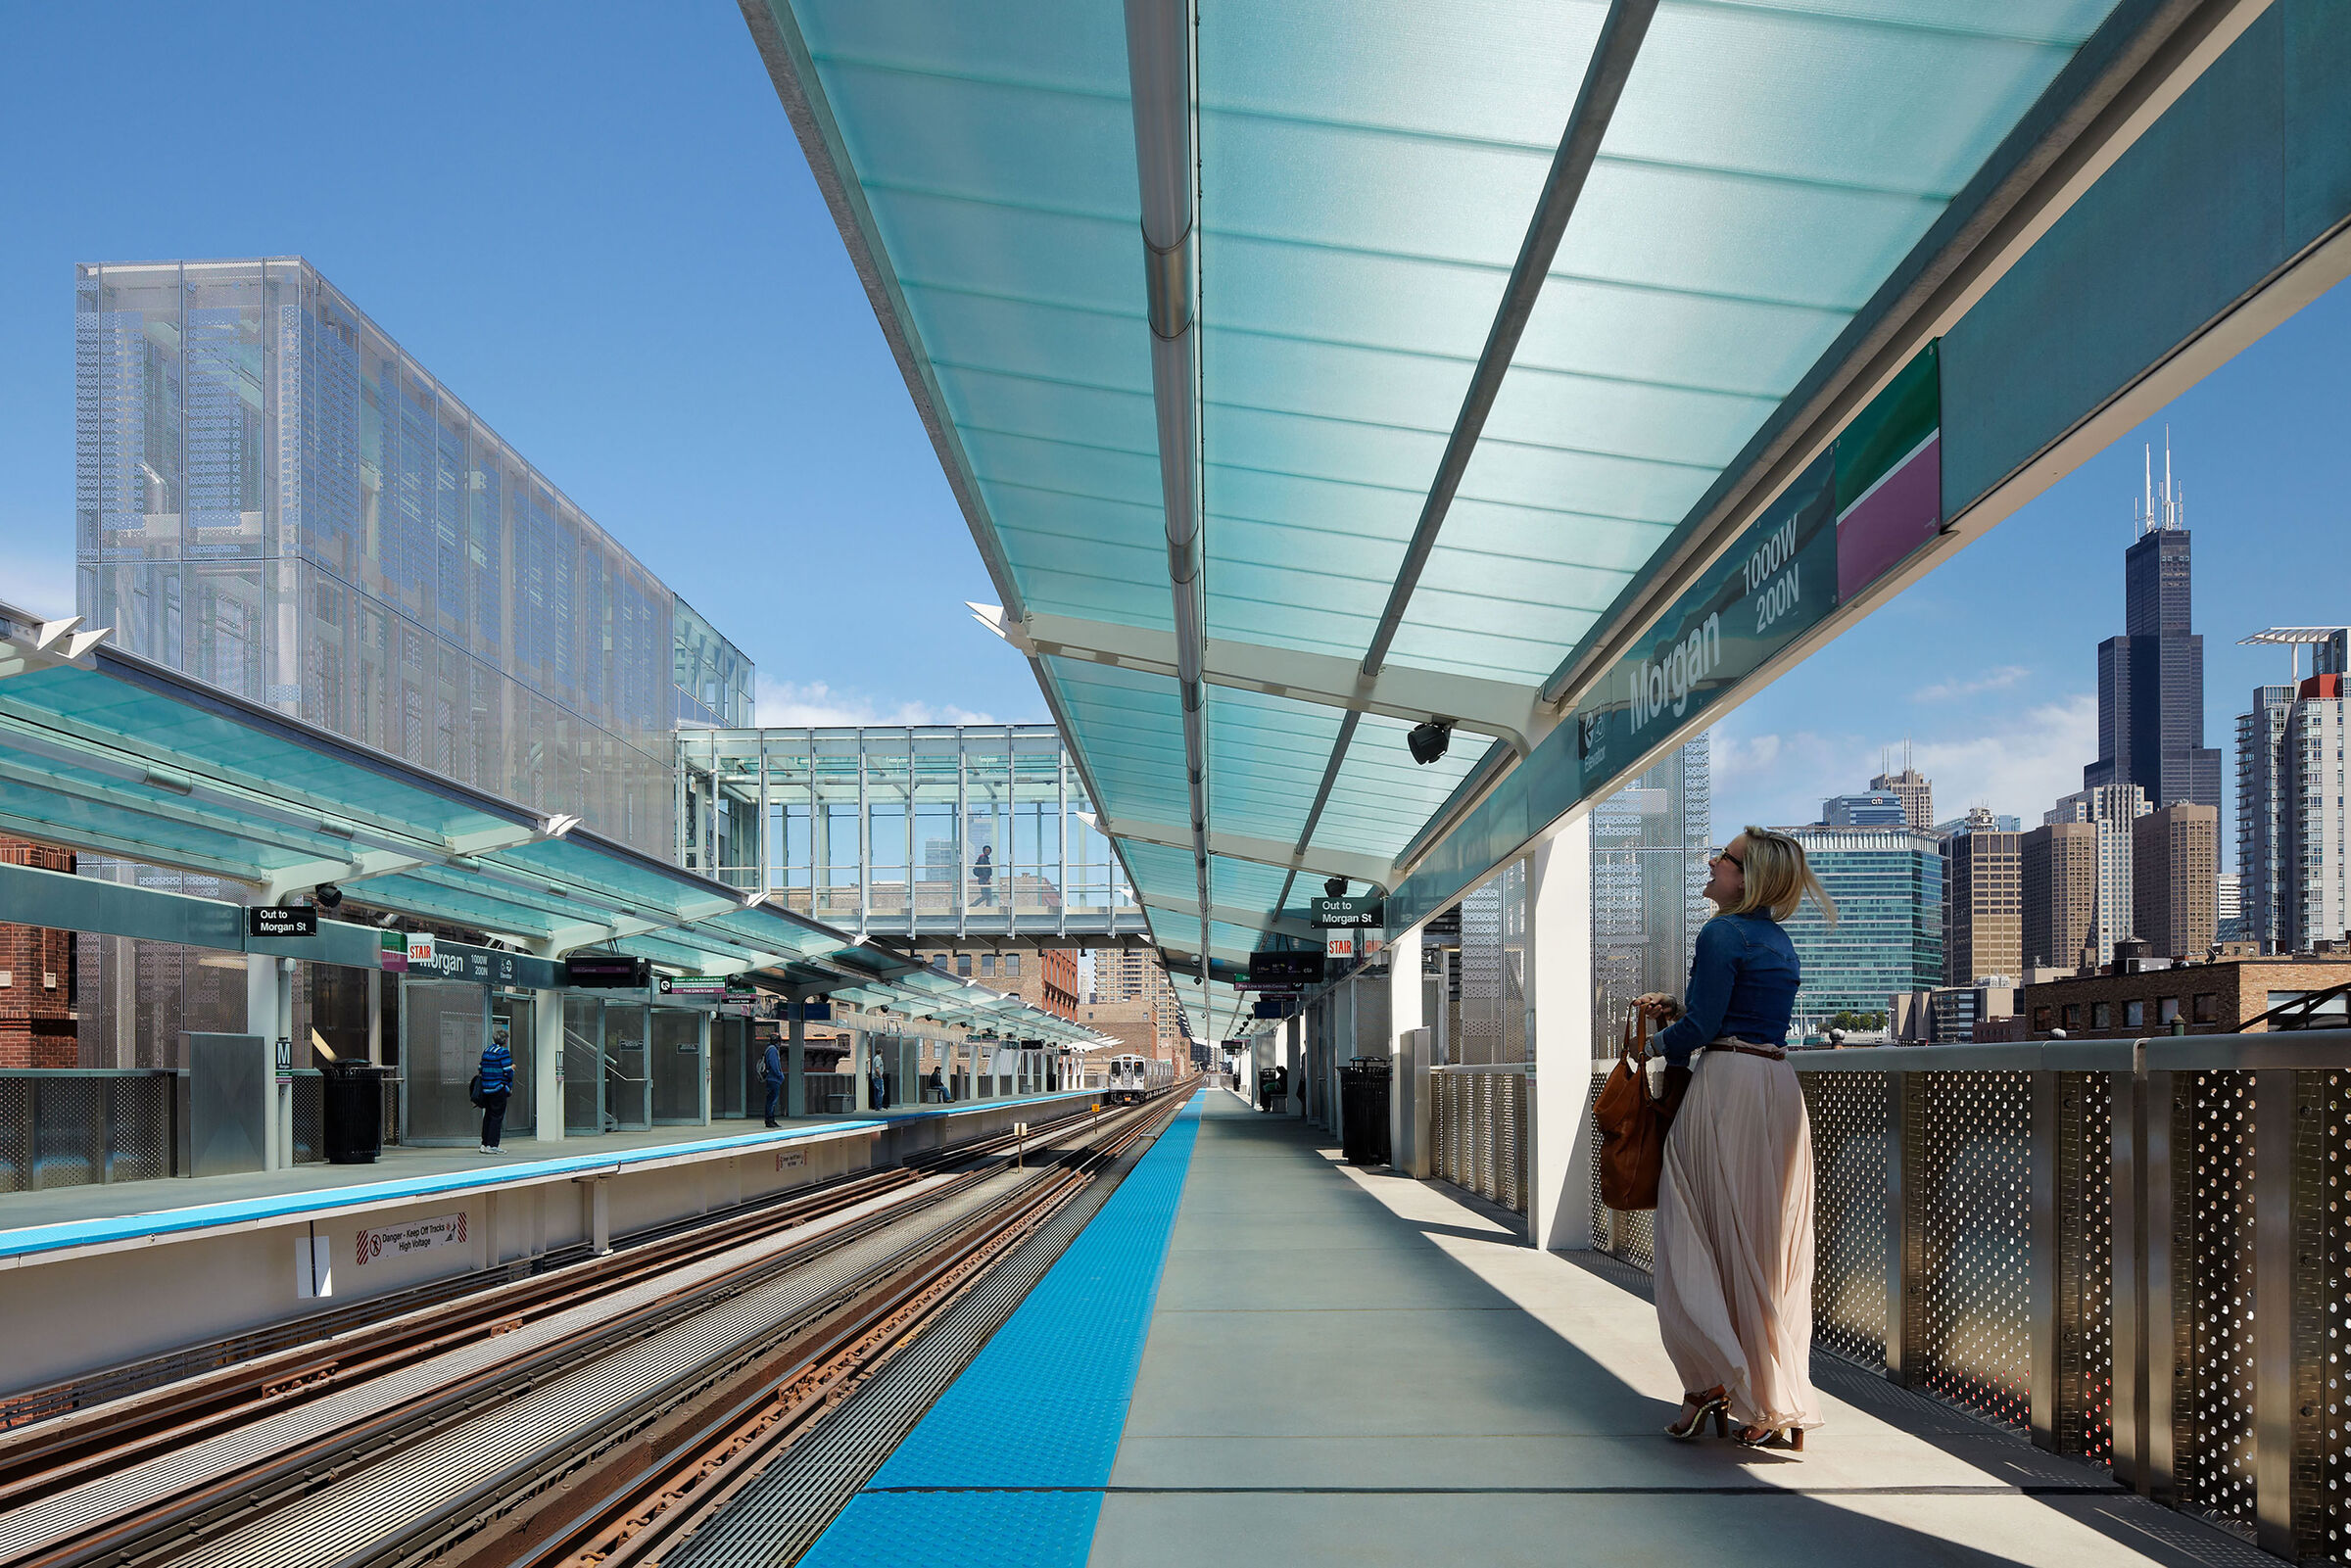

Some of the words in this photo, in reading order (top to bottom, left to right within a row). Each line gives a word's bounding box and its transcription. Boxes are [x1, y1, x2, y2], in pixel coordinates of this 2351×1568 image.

[1743, 512, 1799, 595] 1000W
[1756, 562, 1800, 634] 200N
[1629, 611, 1720, 736] Morgan
[1321, 901, 1340, 910] Out
[1342, 901, 1352, 910] to
[260, 910, 277, 920] Out
[278, 910, 288, 919] to
[1321, 914, 1360, 926] Morgan
[1361, 913, 1372, 923] St
[260, 922, 295, 933] Morgan
[296, 922, 307, 931] St
[409, 945, 431, 960] STAIR
[1328, 940, 1352, 954] STAIR
[470, 954, 489, 966] 1000W
[474, 966, 489, 976] 200N
[277, 1043, 291, 1065] M
[382, 1232, 403, 1243] Danger
[407, 1229, 420, 1238] Keep
[420, 1226, 429, 1235] Off
[429, 1223, 445, 1233] Tracks
[399, 1241, 411, 1252] High
[411, 1238, 431, 1248] Voltage
